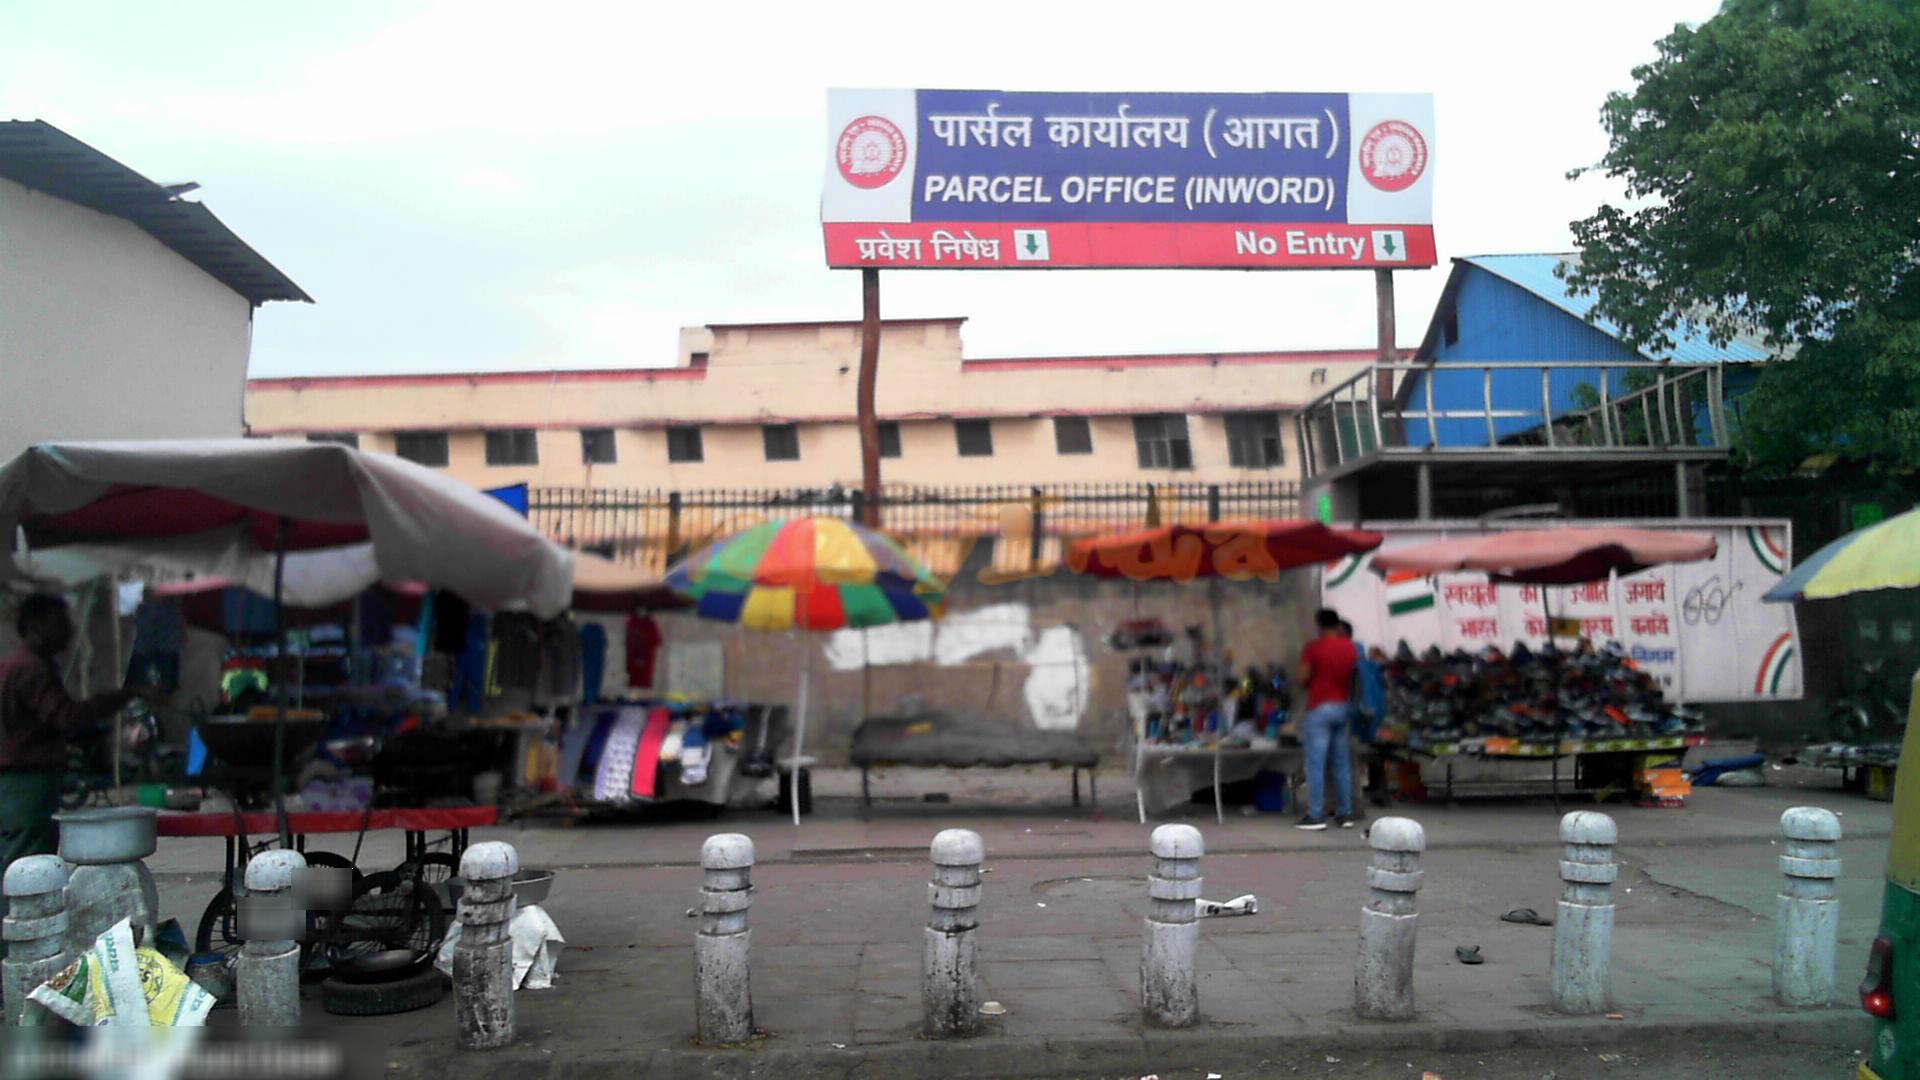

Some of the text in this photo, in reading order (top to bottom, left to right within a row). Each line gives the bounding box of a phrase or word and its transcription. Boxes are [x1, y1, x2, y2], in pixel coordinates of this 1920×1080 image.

[928, 103, 1032, 148] पार्सल
[1044, 104, 1189, 149] कार्यालय
[924, 175, 1335, 211] PARCEL OFFICE (INWORD)
[855, 229, 1000, 261] प्रवेश निषेध
[1234, 230, 1366, 260] No Entry
